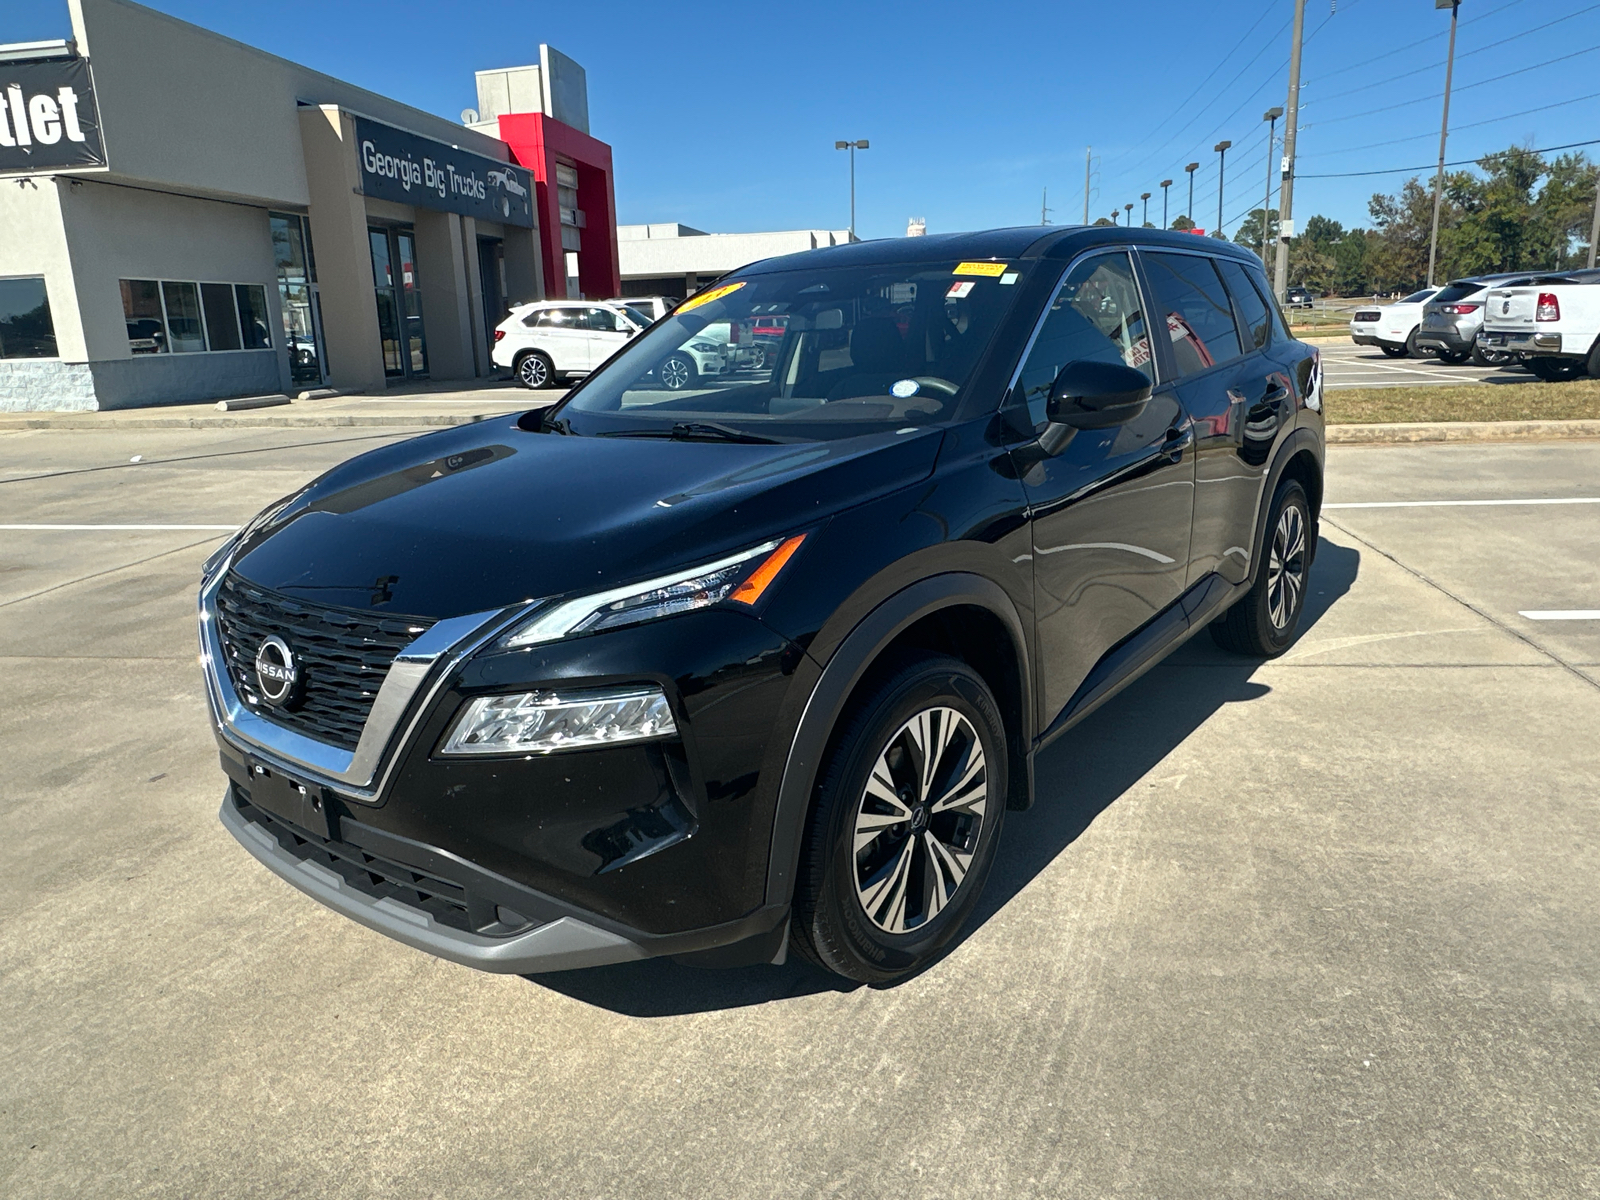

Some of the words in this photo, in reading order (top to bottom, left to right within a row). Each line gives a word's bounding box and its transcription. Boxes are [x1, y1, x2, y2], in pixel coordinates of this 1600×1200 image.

[362, 140, 421, 192] Georgia
[423, 157, 446, 198] Big
[446, 164, 486, 200] Trucks
[255, 658, 295, 681] NISSAN
